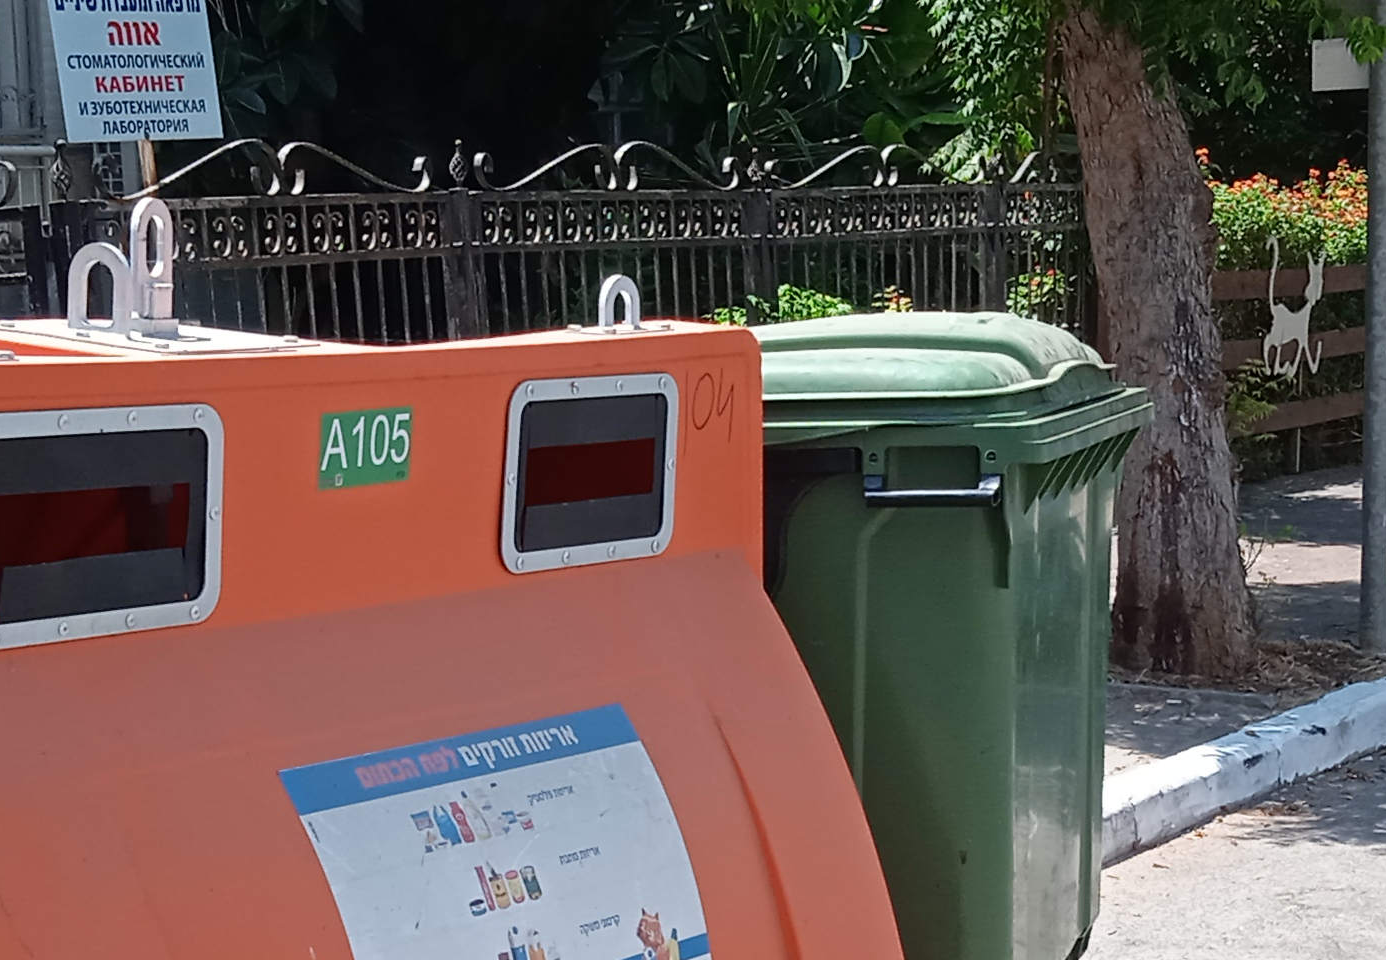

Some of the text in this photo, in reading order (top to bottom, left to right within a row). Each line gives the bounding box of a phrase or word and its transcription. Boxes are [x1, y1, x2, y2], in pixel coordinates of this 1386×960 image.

[107, 20, 162, 46] אווה
[67, 52, 205, 70] СТОМАТОЛОГИЧЕСКИЙ
[95, 75, 184, 93] КАБИНЕТ
[78, 99, 207, 116] И ЗУБОТЕХНИЧЕСКАЯ
[103, 118, 189, 136] ЛАБОРАТОРИЯ
[321, 412, 411, 471] A105
[519, 724, 579, 755] אריזות
[457, 736, 521, 768] זורקים
